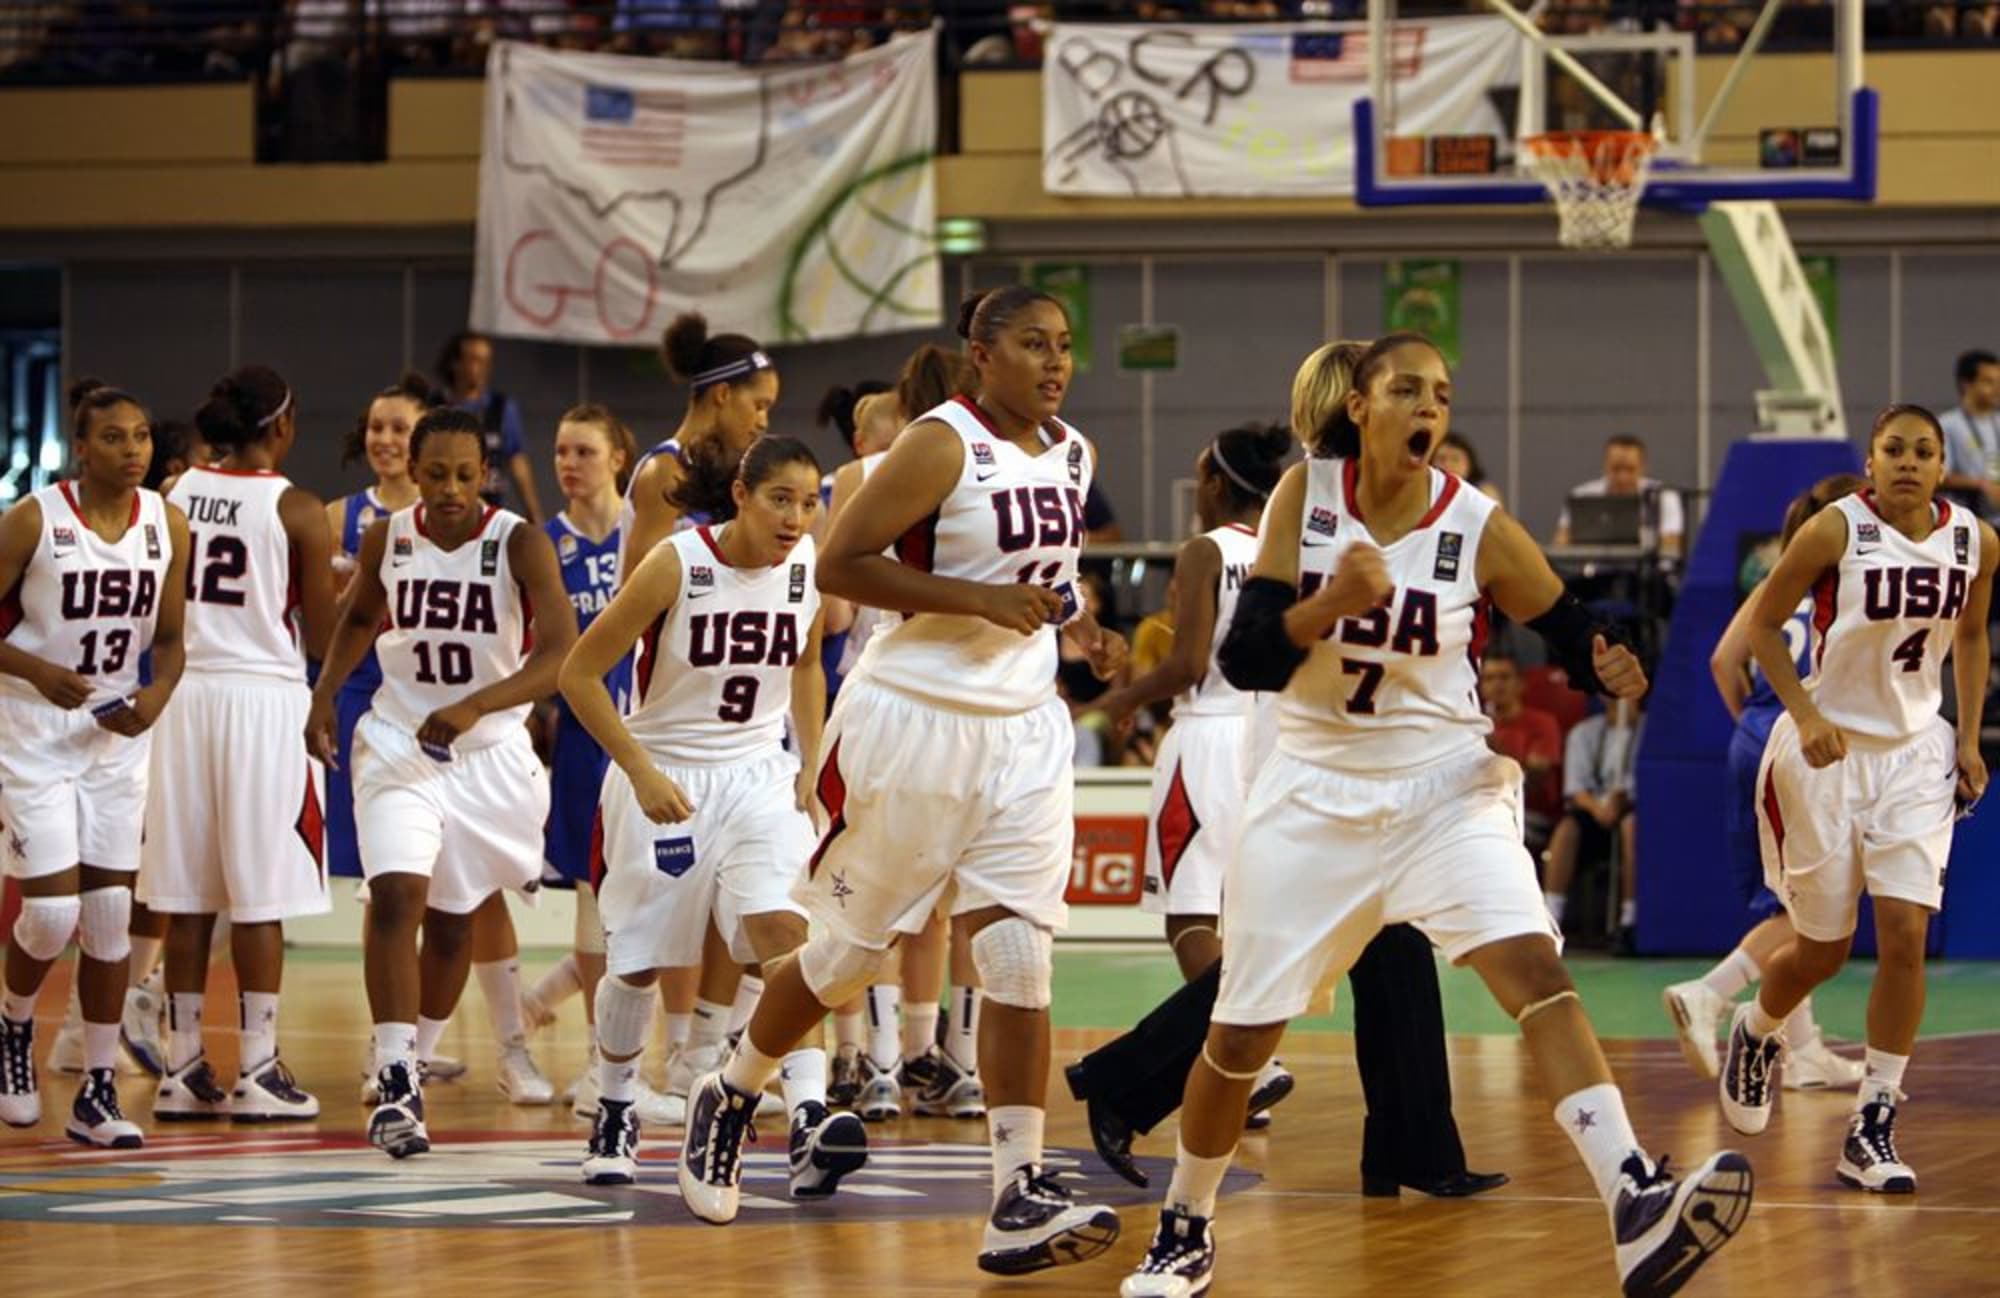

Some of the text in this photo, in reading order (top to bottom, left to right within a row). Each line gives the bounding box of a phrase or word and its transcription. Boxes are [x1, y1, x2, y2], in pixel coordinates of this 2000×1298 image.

[506, 229, 657, 338] GO
[188, 494, 242, 526] TUCK
[991, 487, 1085, 554] USA
[61, 569, 156, 620] USA
[397, 579, 497, 634] USA
[1864, 566, 1966, 621] USA
[76, 629, 131, 675] 13
[412, 641, 473, 685] 10
[688, 611, 799, 667] USA
[1891, 628, 1931, 673] 4
[718, 675, 760, 723] 9
[1342, 657, 1385, 714] 7
